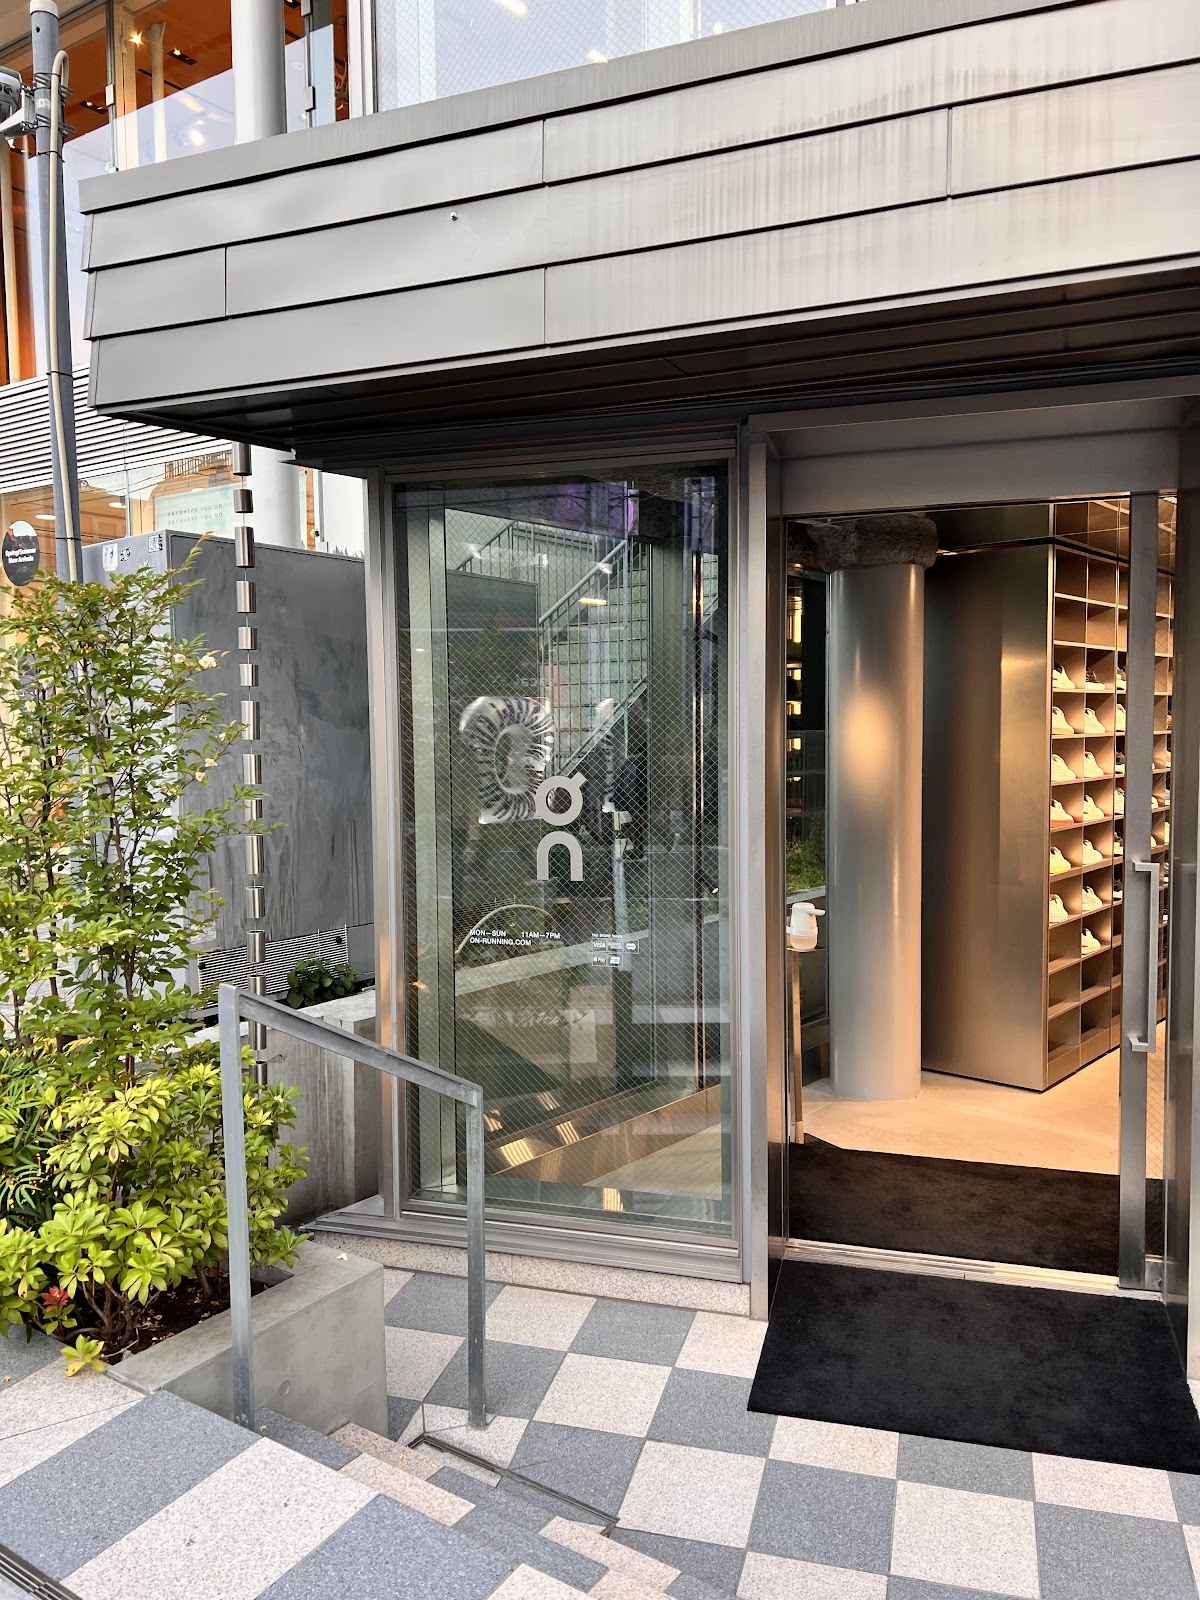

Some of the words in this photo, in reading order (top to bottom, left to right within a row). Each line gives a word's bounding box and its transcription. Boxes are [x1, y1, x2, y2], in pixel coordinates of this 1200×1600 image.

[167, 508, 198, 517] ANYWHERE
[167, 516, 198, 525] ANYWHERE
[469, 937, 532, 946] ON-RUNNING.COM
